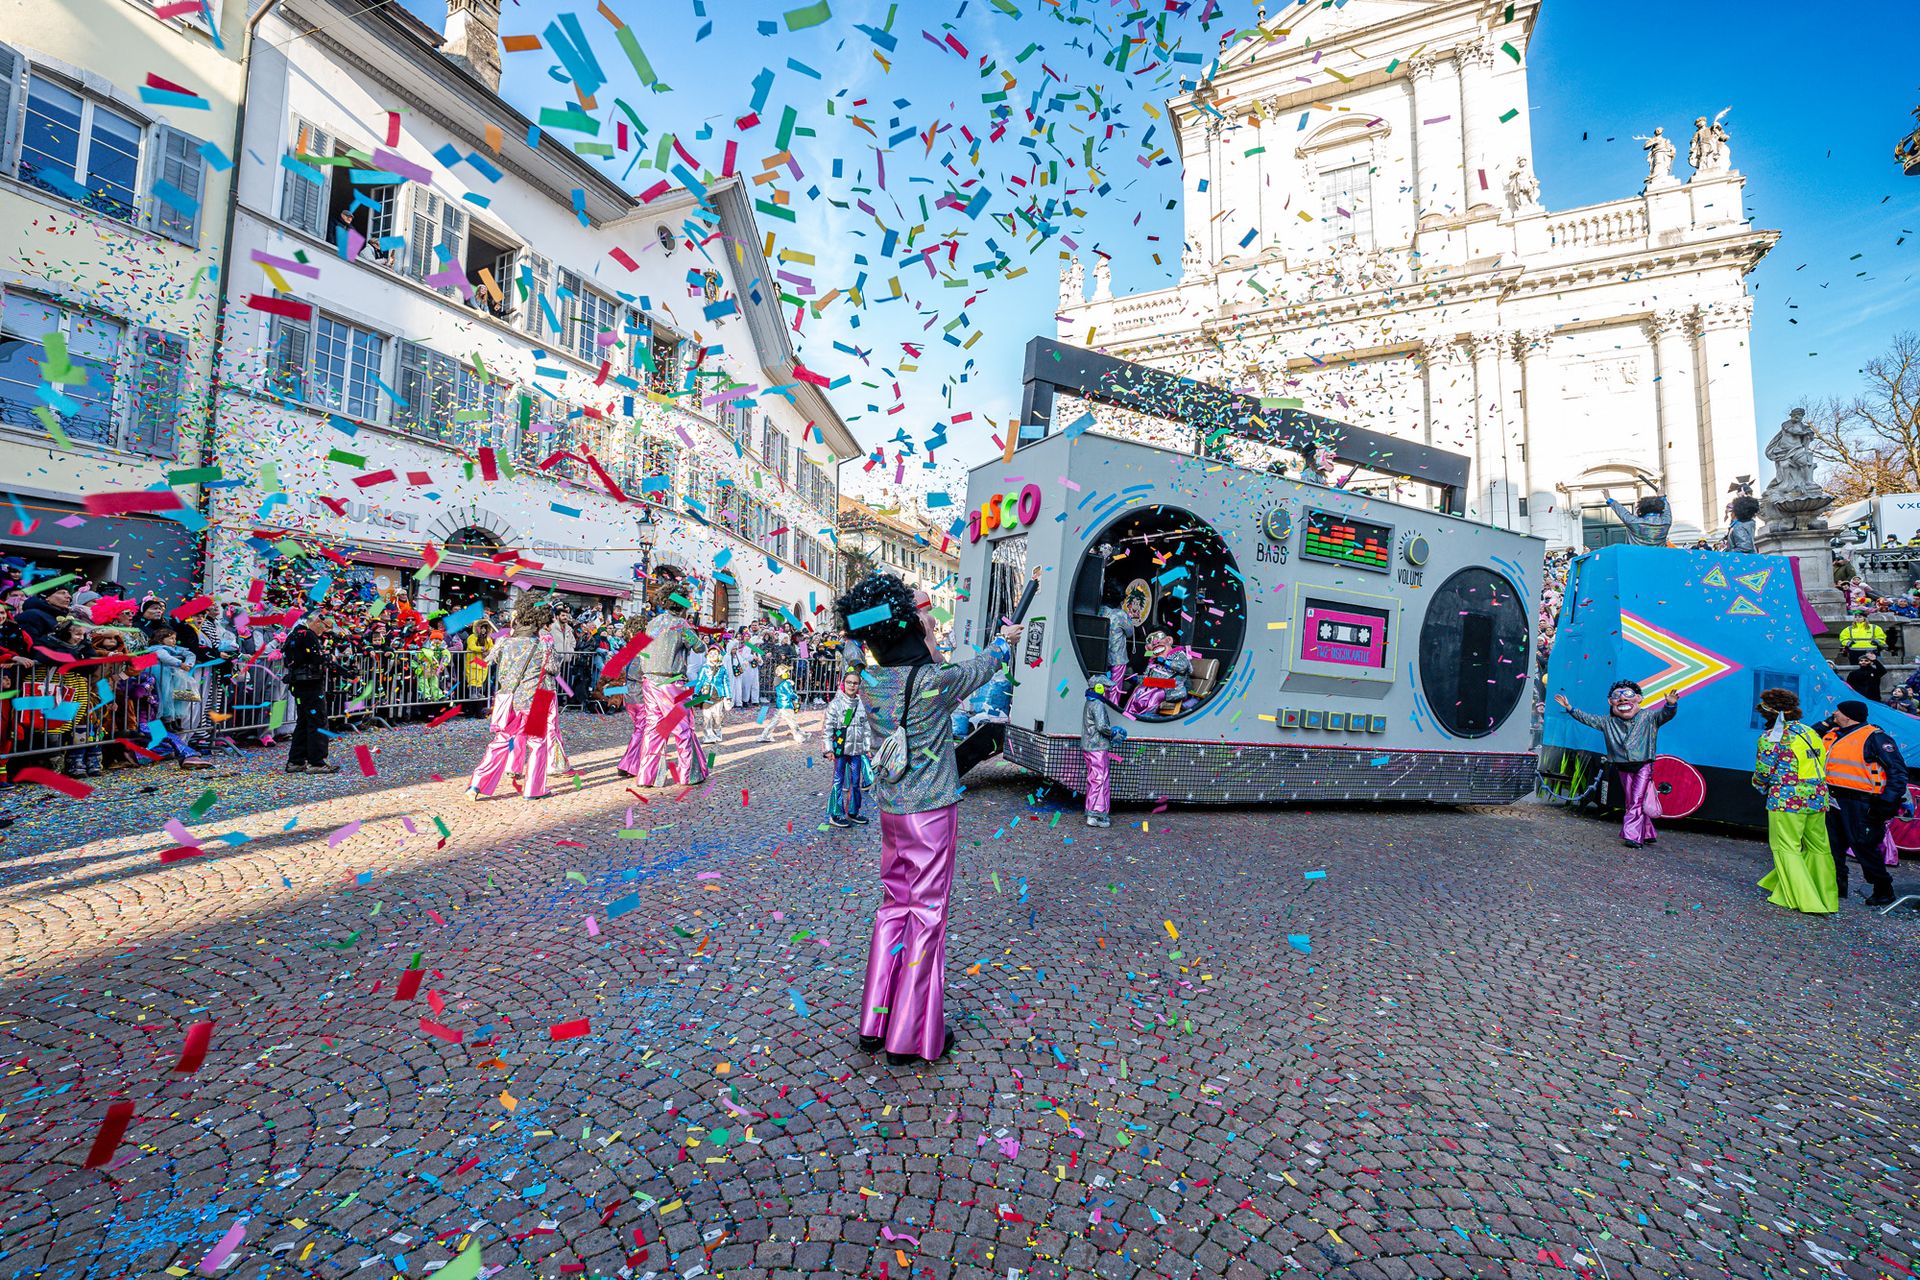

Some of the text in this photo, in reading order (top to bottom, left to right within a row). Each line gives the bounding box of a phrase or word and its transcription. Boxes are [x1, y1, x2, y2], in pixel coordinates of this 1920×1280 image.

[969, 484, 1041, 544] DISCO
[532, 539, 595, 566] CENTER
[1256, 542, 1288, 565] BASS
[1397, 569, 1424, 587] VOLUME
